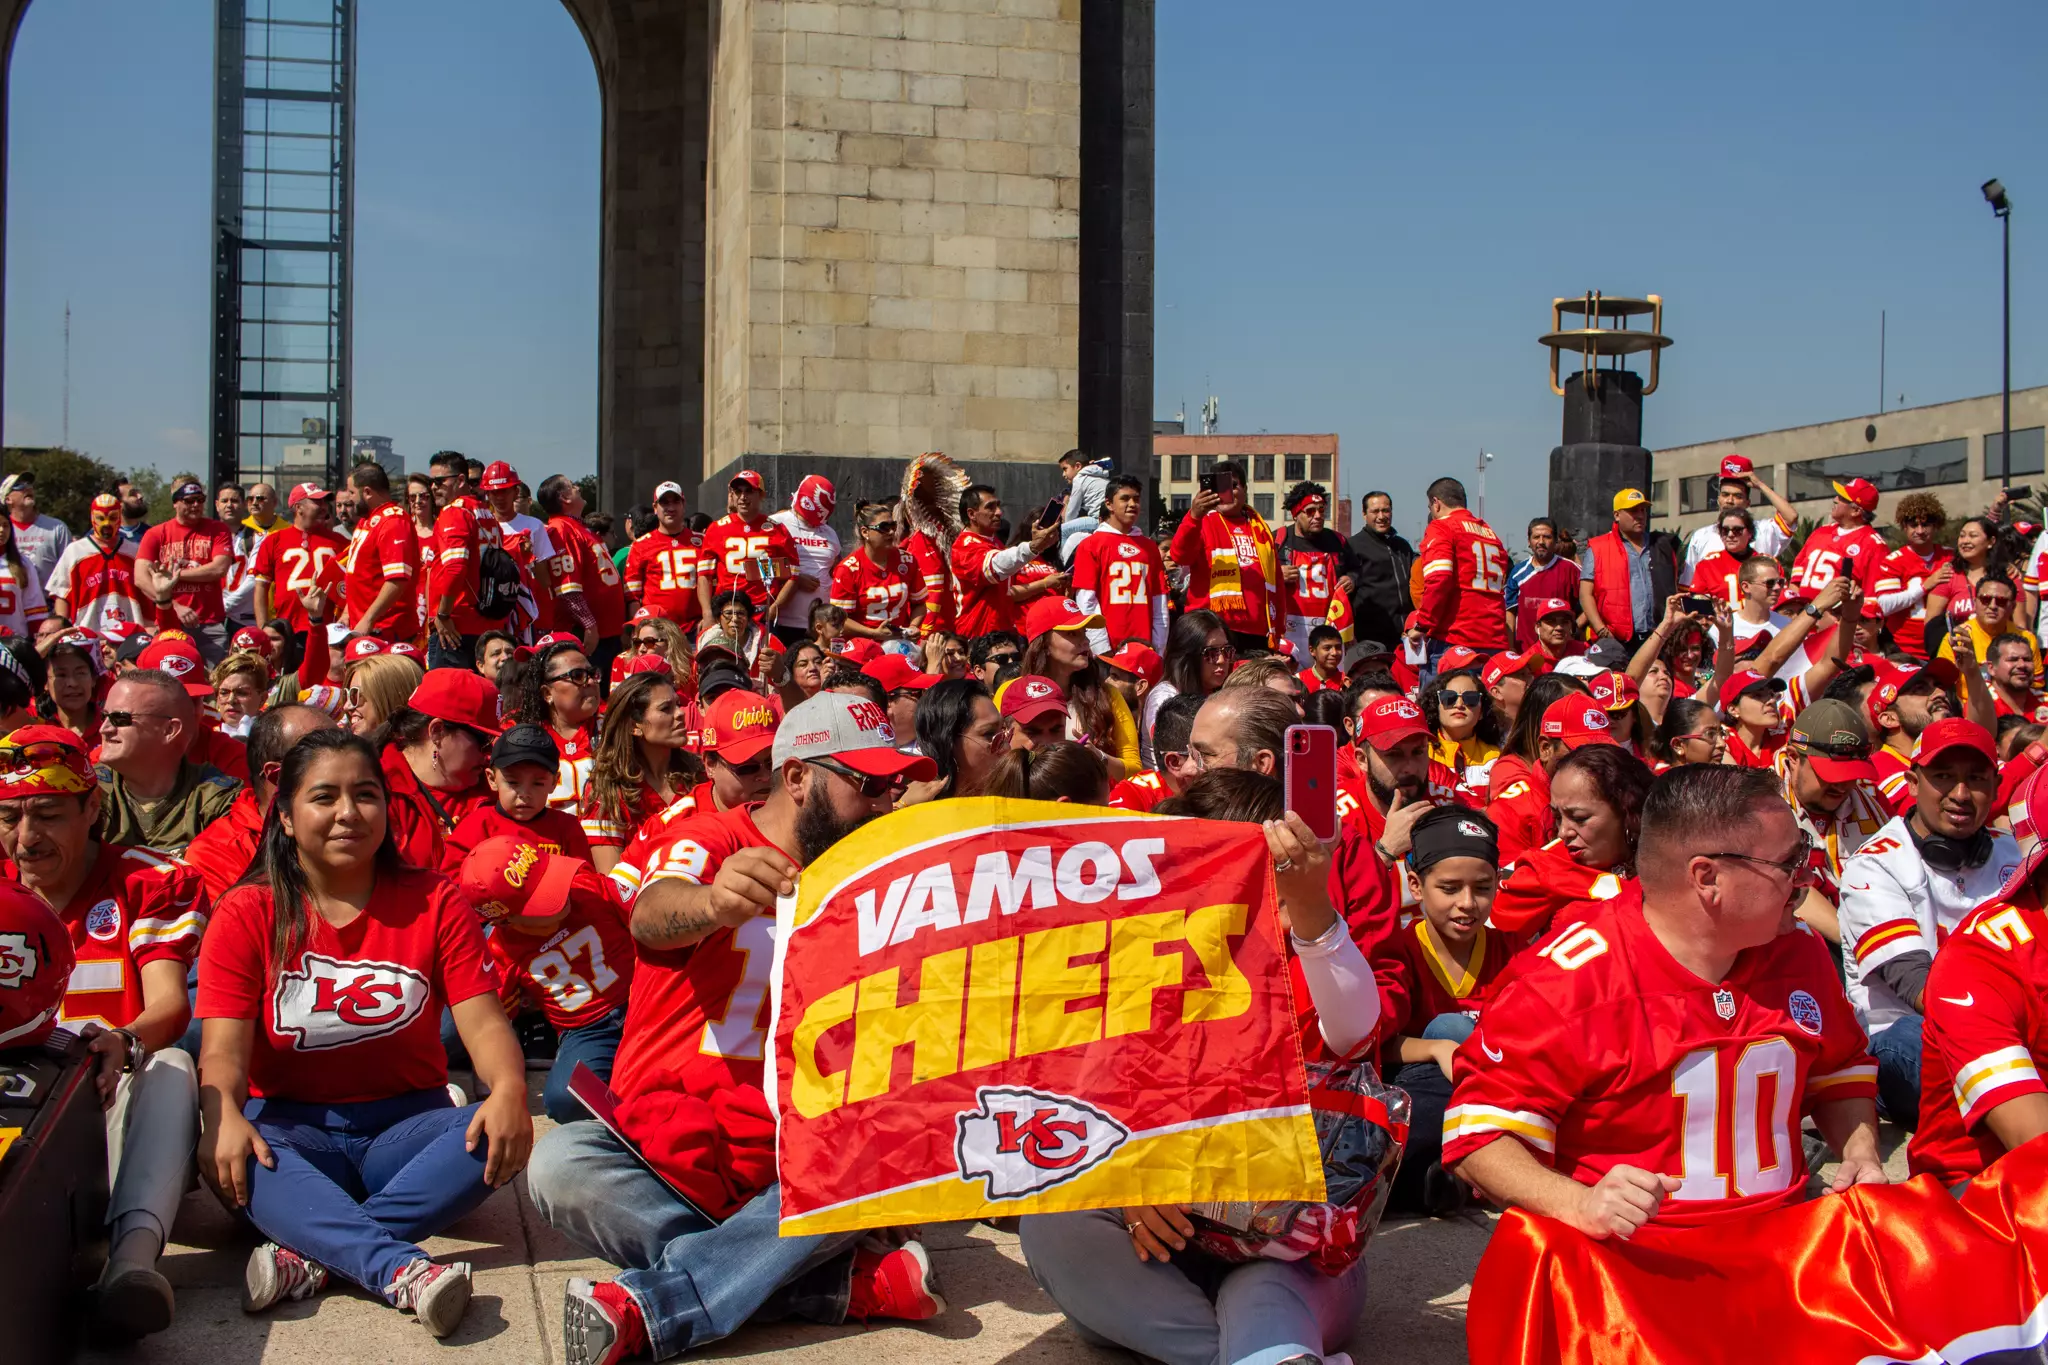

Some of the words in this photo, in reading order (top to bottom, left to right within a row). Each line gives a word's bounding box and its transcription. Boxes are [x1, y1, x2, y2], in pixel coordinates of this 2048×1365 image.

[551, 554, 574, 577] 58
[656, 549, 698, 591] 15
[1108, 561, 1149, 605] 27
[1212, 568, 1237, 579] CHIEFS
[1471, 540, 1504, 593] 15
[1800, 548, 1842, 590] 15
[866, 582, 909, 621] 27
[732, 705, 774, 731] Chiefs
[793, 730, 831, 747] JOHNSON
[504, 843, 537, 889] Chiefs
[854, 837, 1166, 957] VAMOS
[540, 928, 570, 953] CHIEFS
[1537, 921, 1608, 970] 10
[528, 925, 620, 1013] 87
[791, 903, 1253, 1119] CHIEFS
[1671, 1036, 1798, 1200] 10
